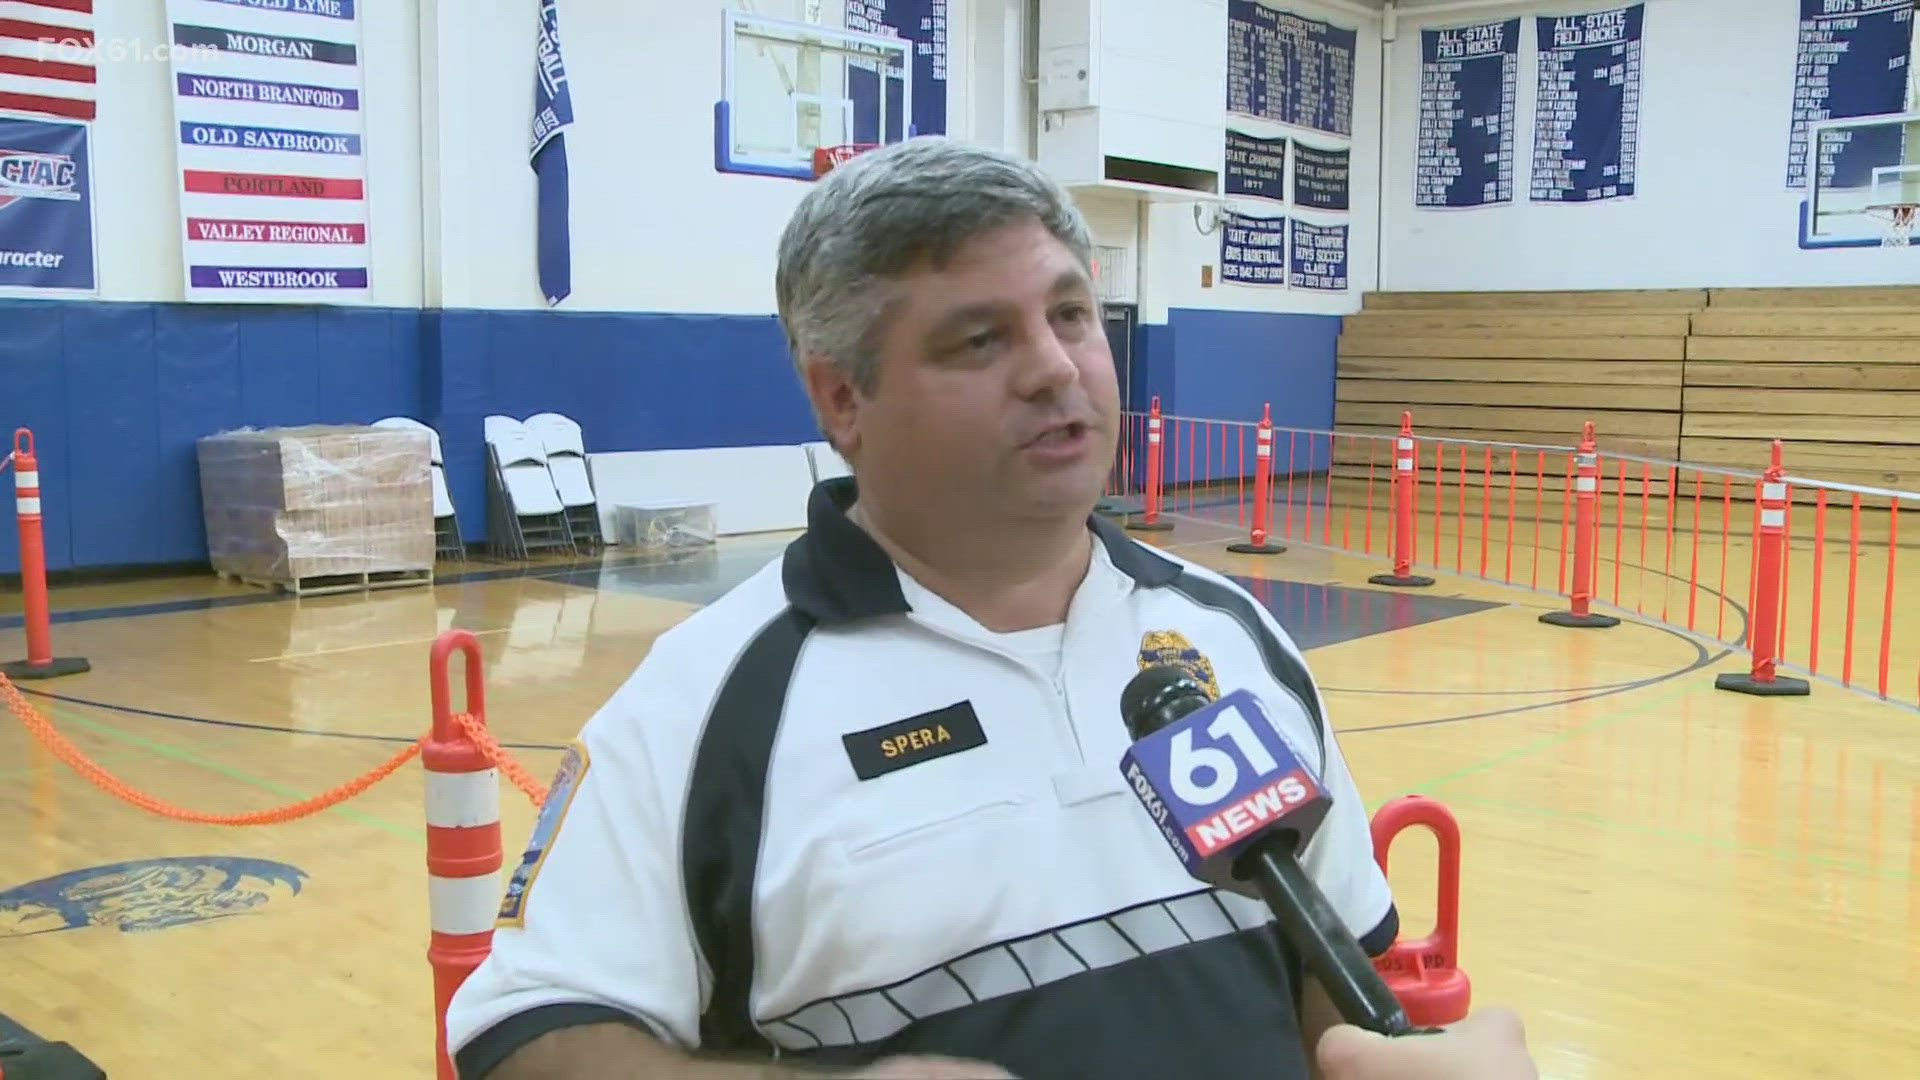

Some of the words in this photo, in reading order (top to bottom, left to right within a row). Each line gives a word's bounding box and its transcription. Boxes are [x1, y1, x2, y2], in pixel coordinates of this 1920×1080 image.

[1554, 9, 1626, 30] ALL-STATE
[1437, 24, 1503, 43] ALL-STATE
[1553, 31, 1582, 45] FIELD
[1585, 25, 1626, 43] HOCKEY
[225, 33, 314, 59] MORGAN
[1436, 42, 1464, 58] FIELD
[1466, 35, 1503, 55] HOCKEY
[192, 79, 254, 99] NORTH
[258, 85, 345, 107] BRANFORD
[192, 127, 239, 145] OLD
[244, 131, 349, 153] SAYBROOK
[1226, 149, 1247, 164] STATE
[1, 158, 76, 187] CIAC
[1296, 163, 1315, 176] STATE
[223, 176, 326, 195] PORTLAND
[198, 222, 265, 240] VALLEY
[269, 225, 353, 243] REGIONAL
[218, 270, 338, 287] WESTBROOK
[881, 724, 952, 757] SPERA
[1170, 705, 1278, 806] 61
[1127, 763, 1189, 863] FOX61.com
[1195, 776, 1307, 848] NEWS
